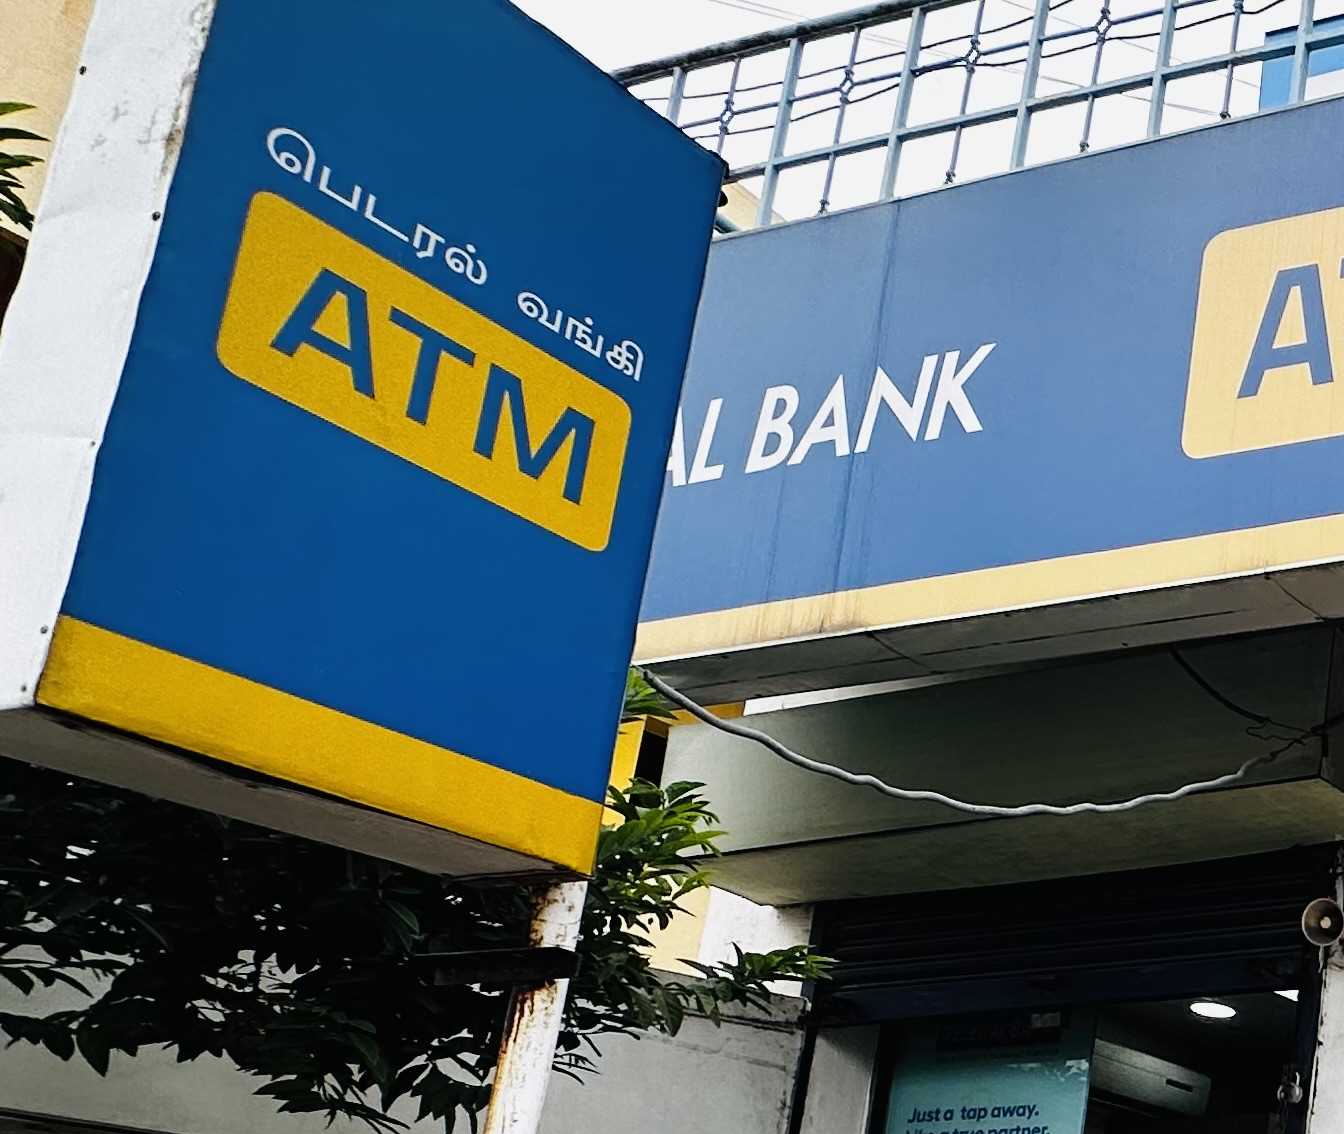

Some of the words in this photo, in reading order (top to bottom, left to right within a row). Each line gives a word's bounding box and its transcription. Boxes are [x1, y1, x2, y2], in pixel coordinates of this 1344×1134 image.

[267, 127, 489, 286] பெடரல்
[518, 289, 644, 382] வங்கி
[271, 269, 594, 506] ATM
[745, 342, 998, 474] BANK
[907, 1108, 941, 1123] Just
[944, 1109, 954, 1120] a
[961, 1106, 988, 1121] tap
[991, 1104, 1039, 1120] away.
